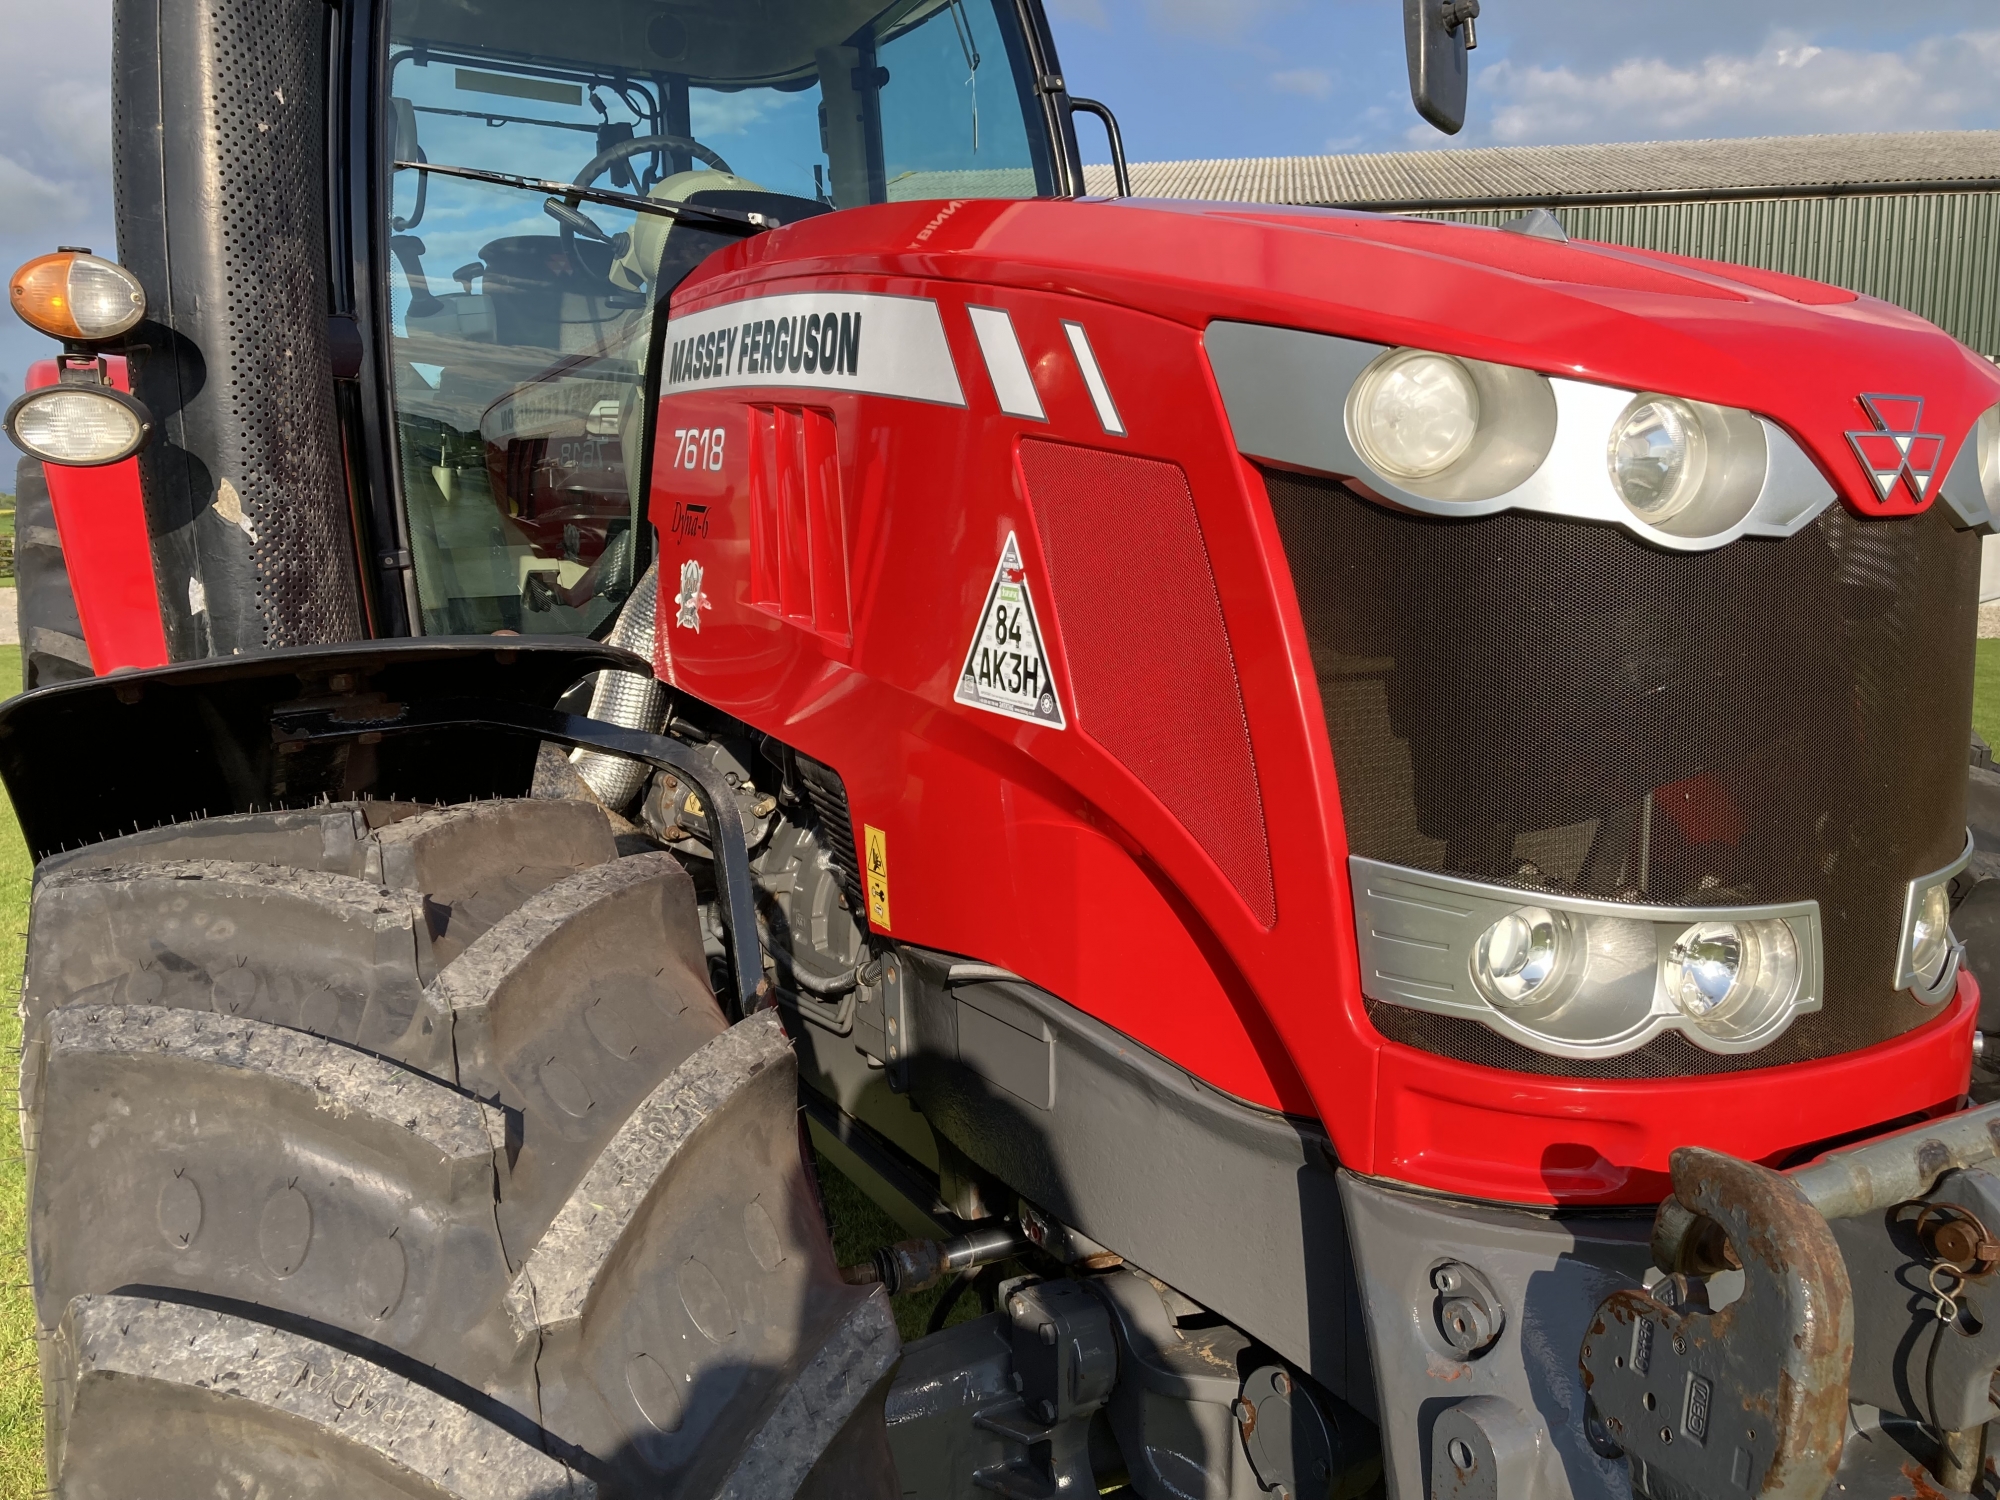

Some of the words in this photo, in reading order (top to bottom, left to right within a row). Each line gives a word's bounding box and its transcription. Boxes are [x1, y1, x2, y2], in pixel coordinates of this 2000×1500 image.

[669, 326, 738, 385] MASSEY
[737, 312, 862, 376] FERGUSON
[673, 427, 726, 471] 7618
[671, 501, 712, 546] Dyna-6
[995, 604, 1021, 648] 84
[979, 647, 1039, 699] AK3H
[291, 1357, 410, 1432] RADIAL
